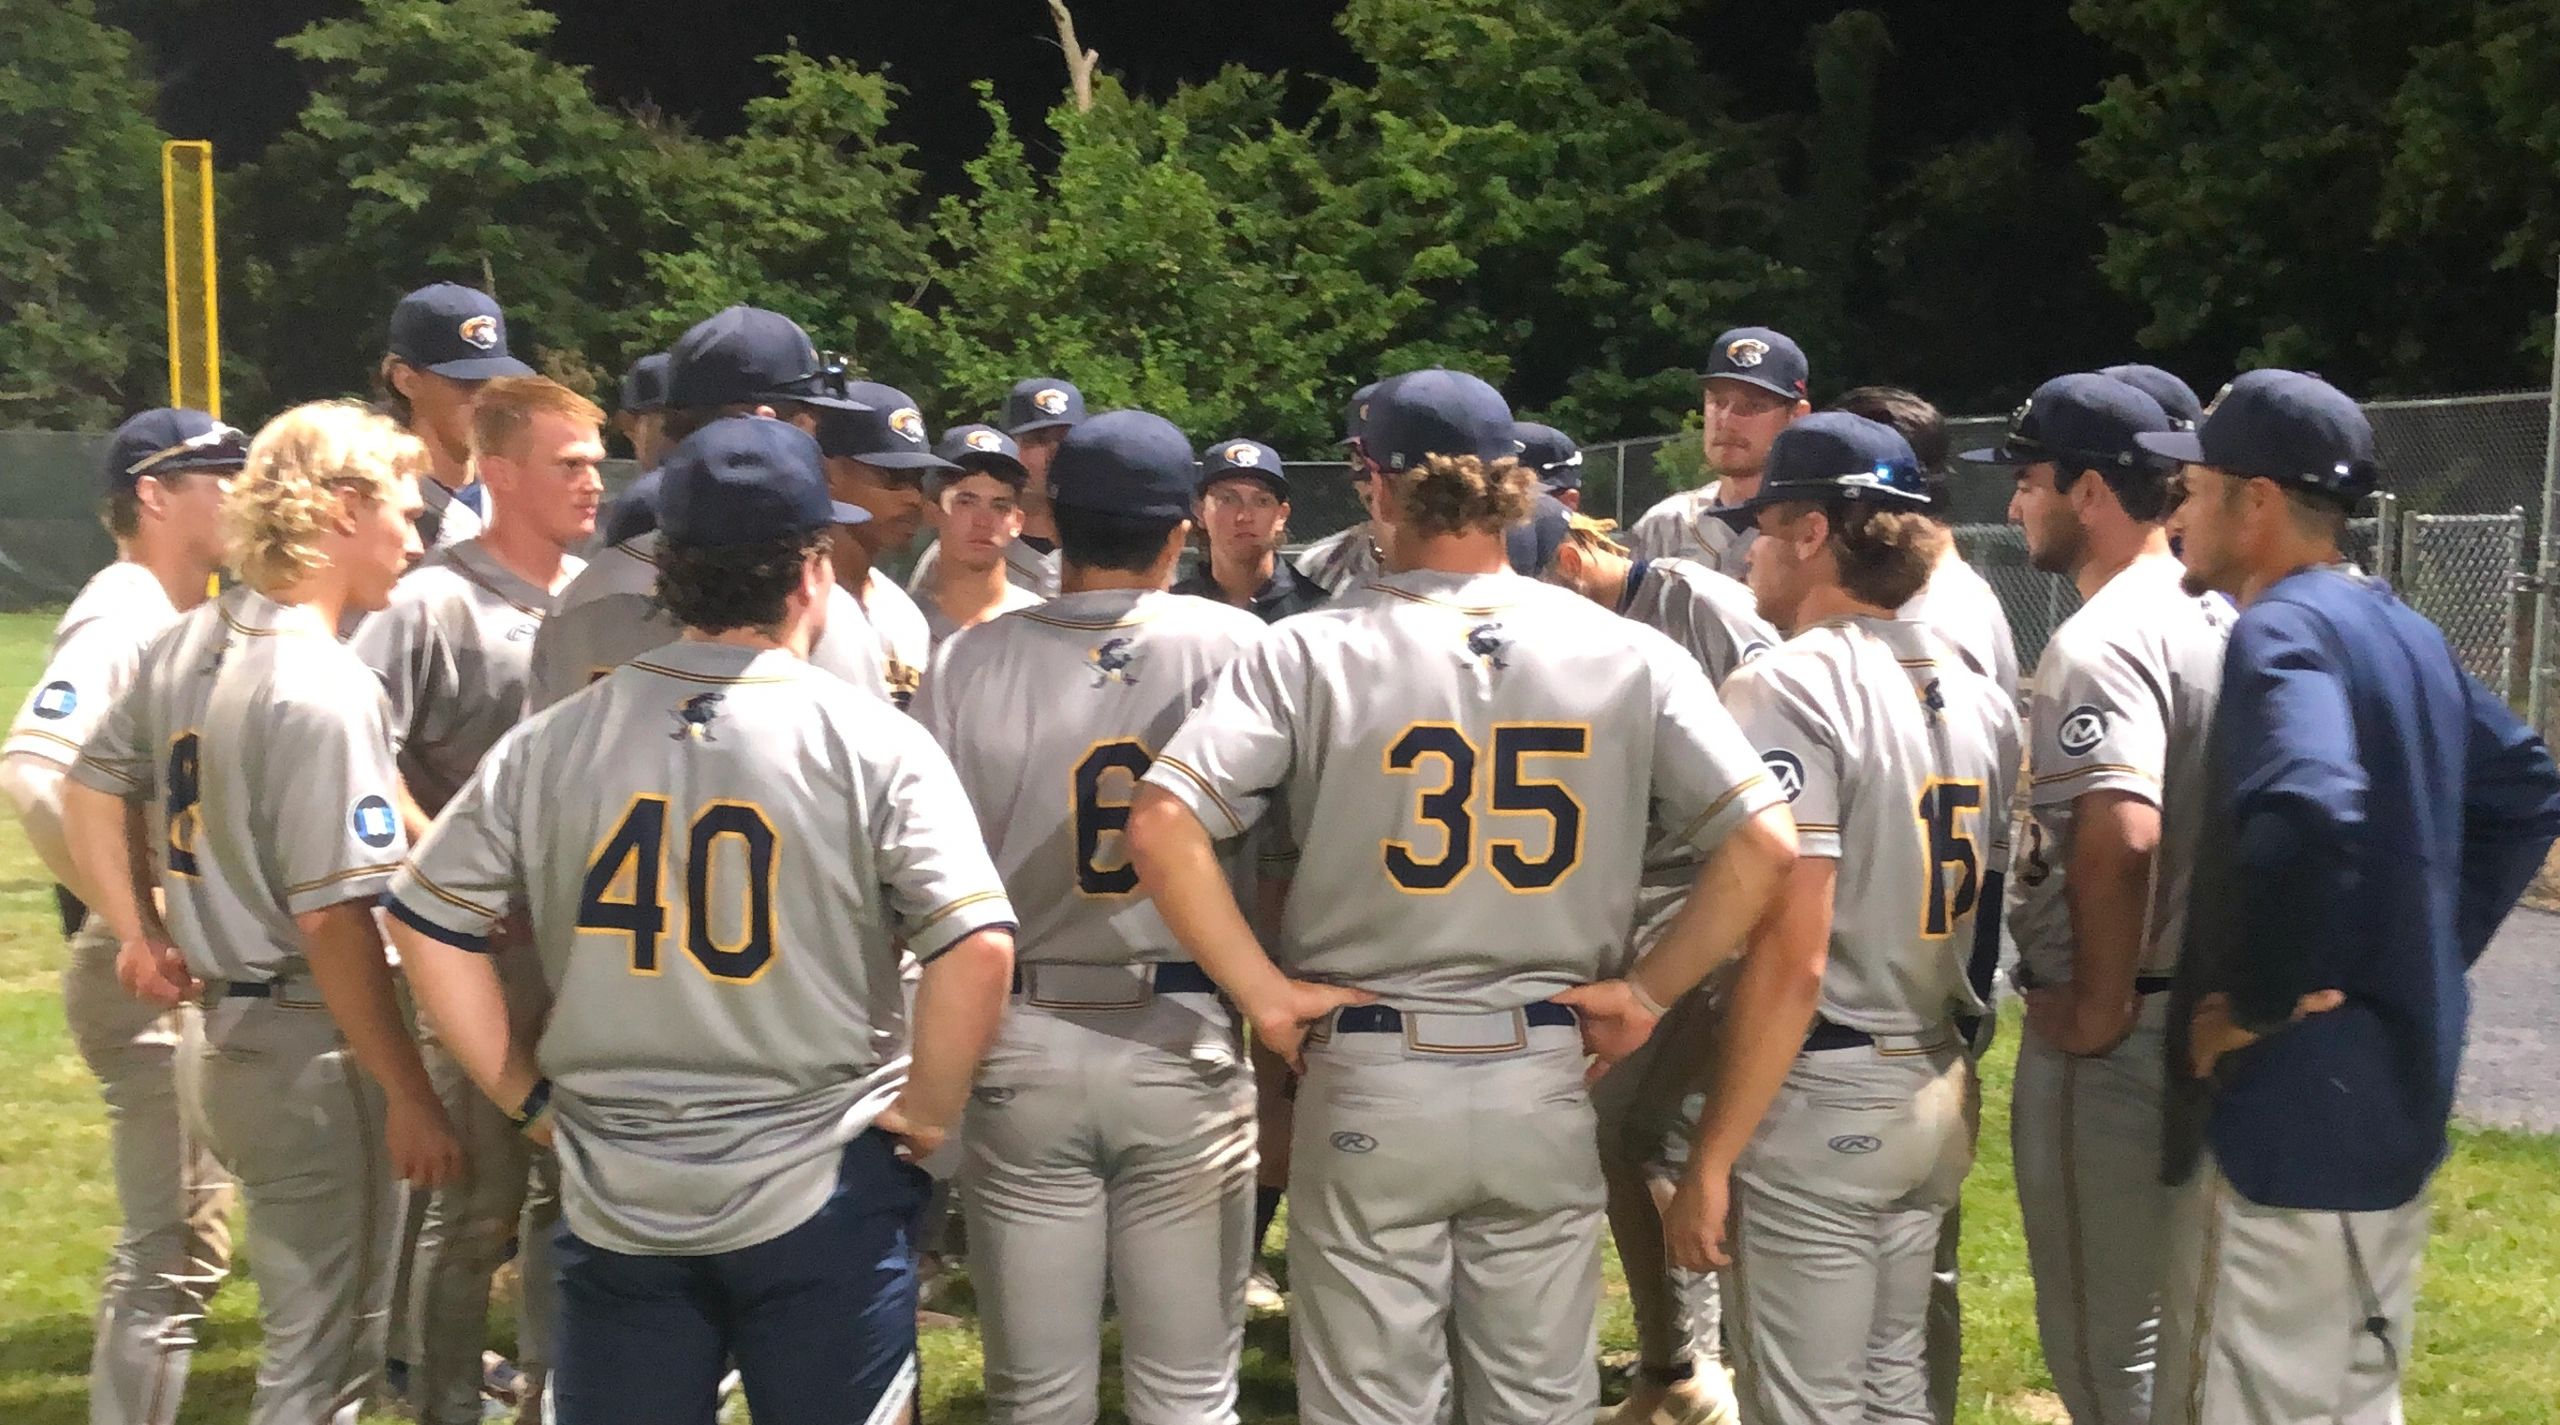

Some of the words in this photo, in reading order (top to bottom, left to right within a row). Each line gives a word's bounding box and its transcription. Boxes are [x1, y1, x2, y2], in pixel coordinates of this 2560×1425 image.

[574, 792, 782, 985] 40
[1380, 721, 1592, 895] 35
[1915, 774, 1985, 940] 15
